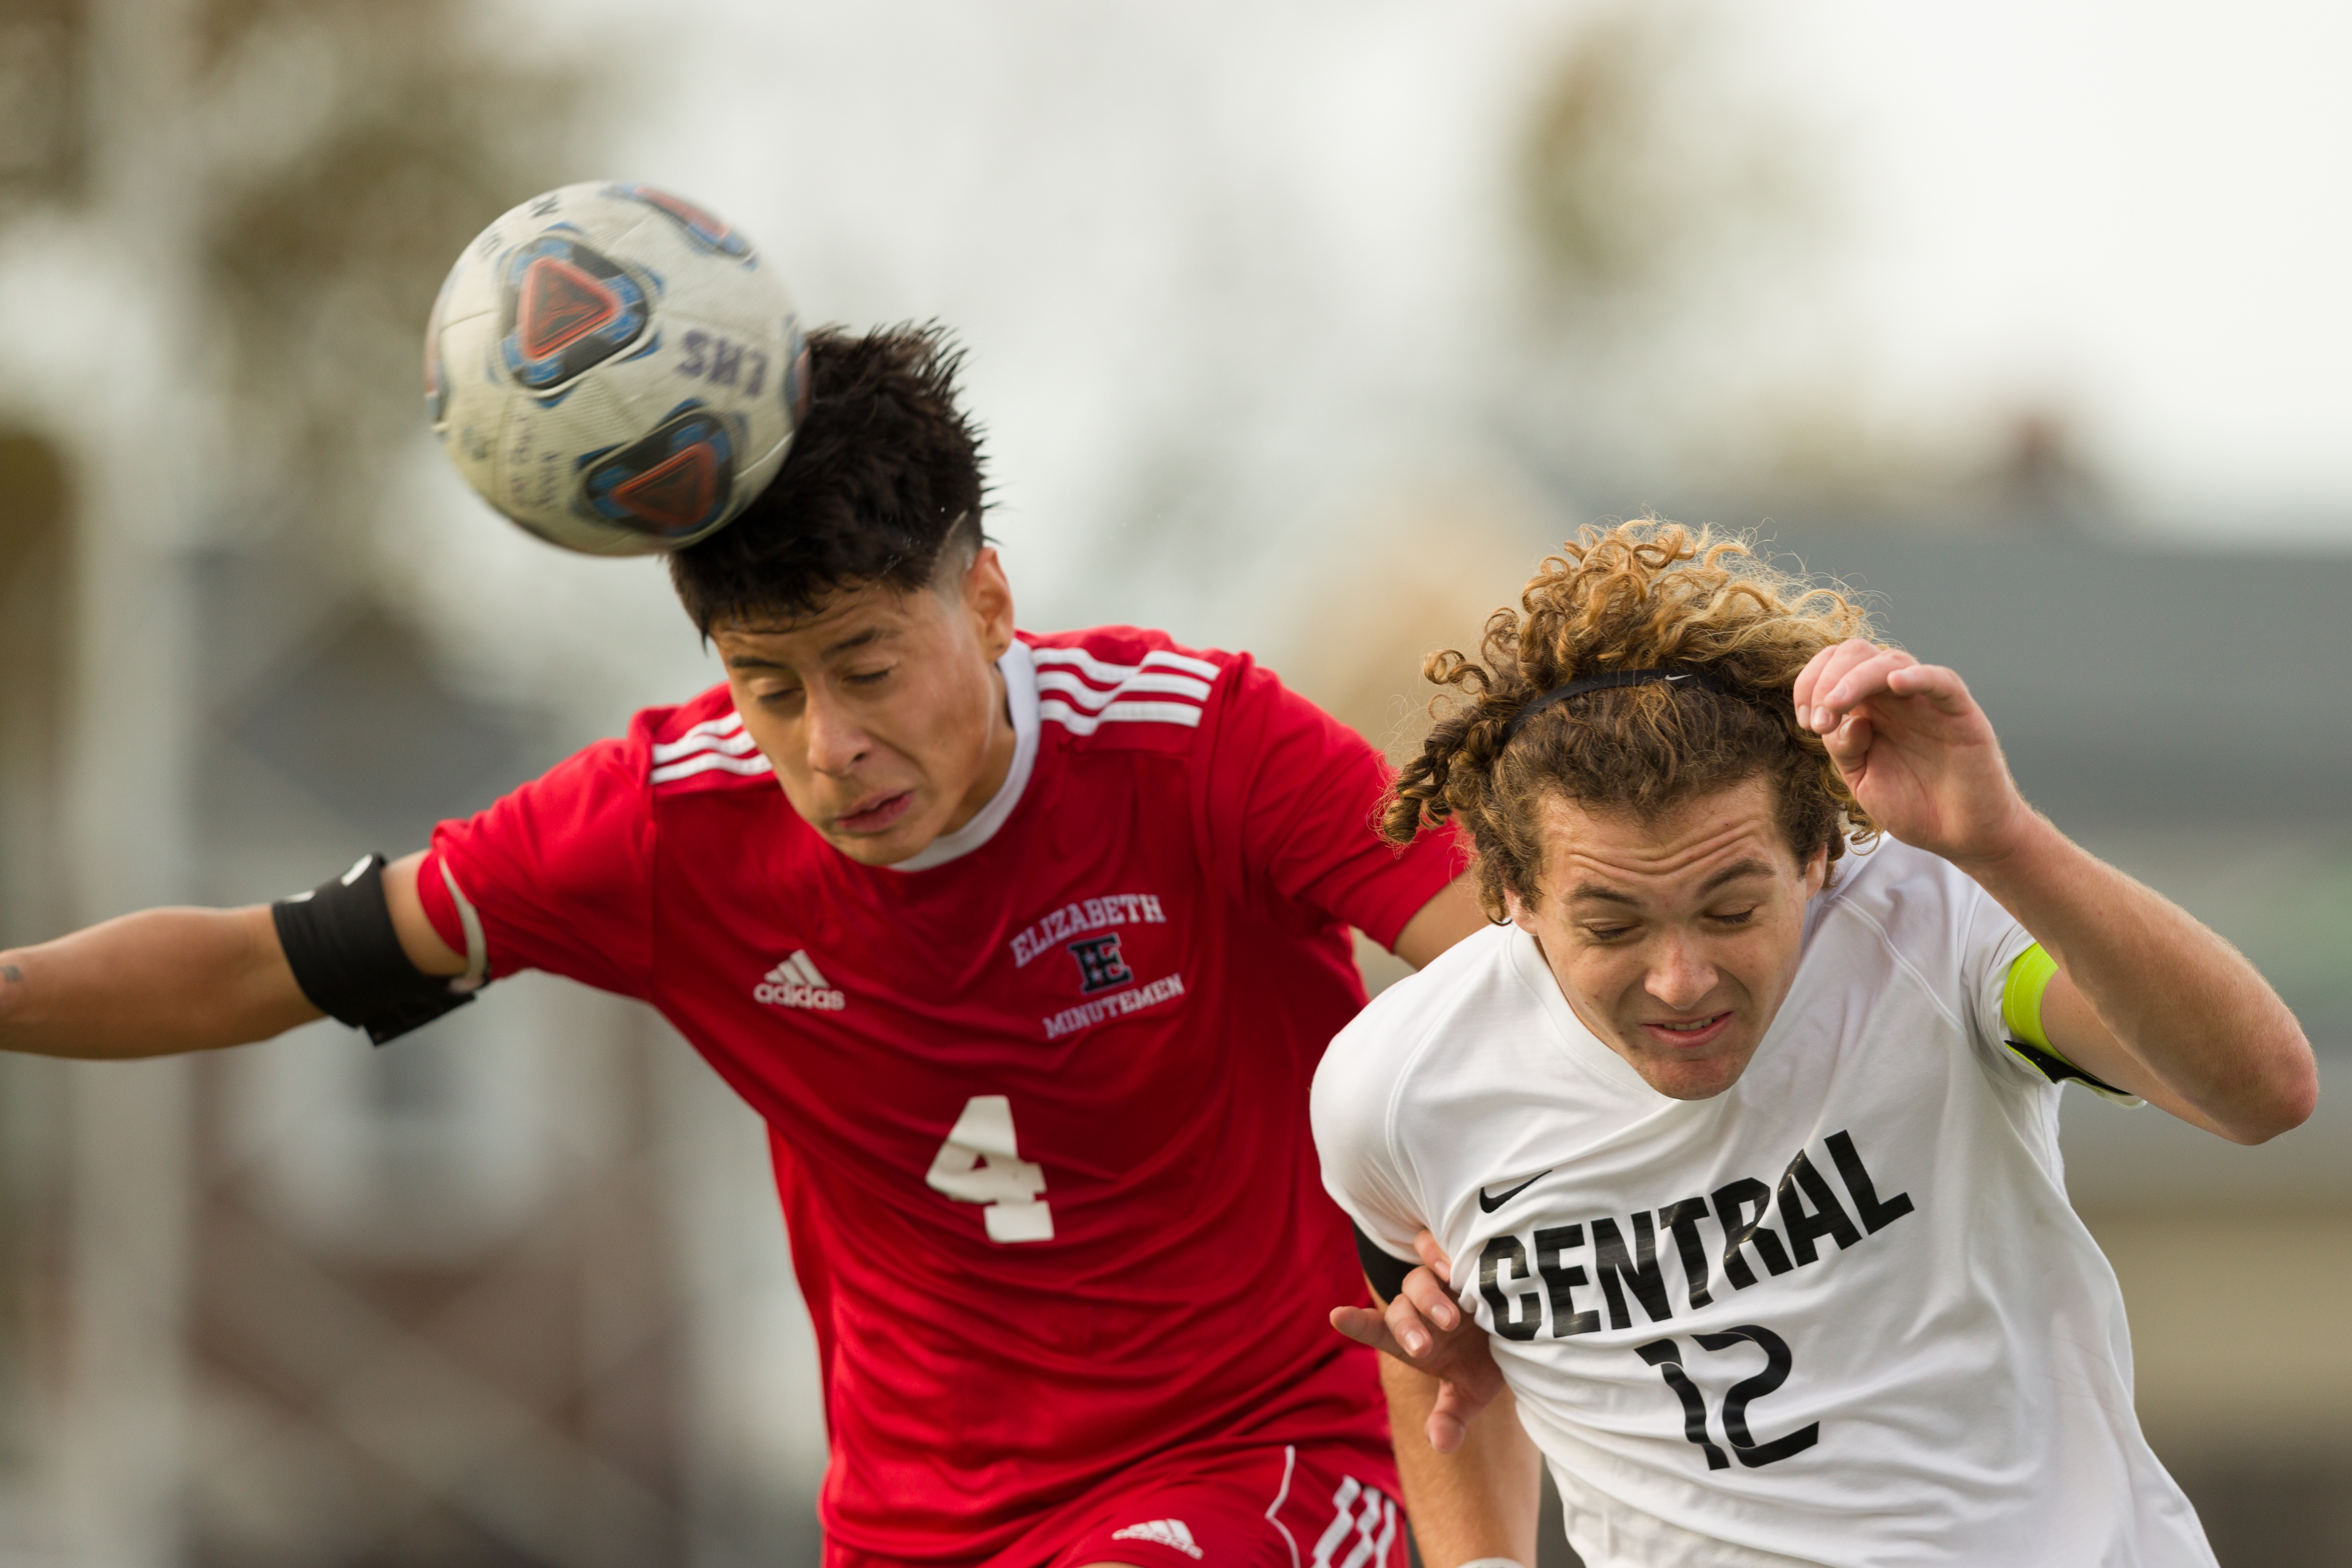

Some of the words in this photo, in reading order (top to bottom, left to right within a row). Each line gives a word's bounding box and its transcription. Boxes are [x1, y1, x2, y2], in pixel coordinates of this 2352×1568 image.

[1009, 894, 1166, 968] ELIZABETH
[753, 981, 846, 1011] adidas
[1042, 973, 1186, 1040] MINUTEMEN
[925, 1094, 1055, 1244] 4
[1479, 1129, 1915, 1341] CENTRAL
[1633, 1324, 1820, 1470] 12
